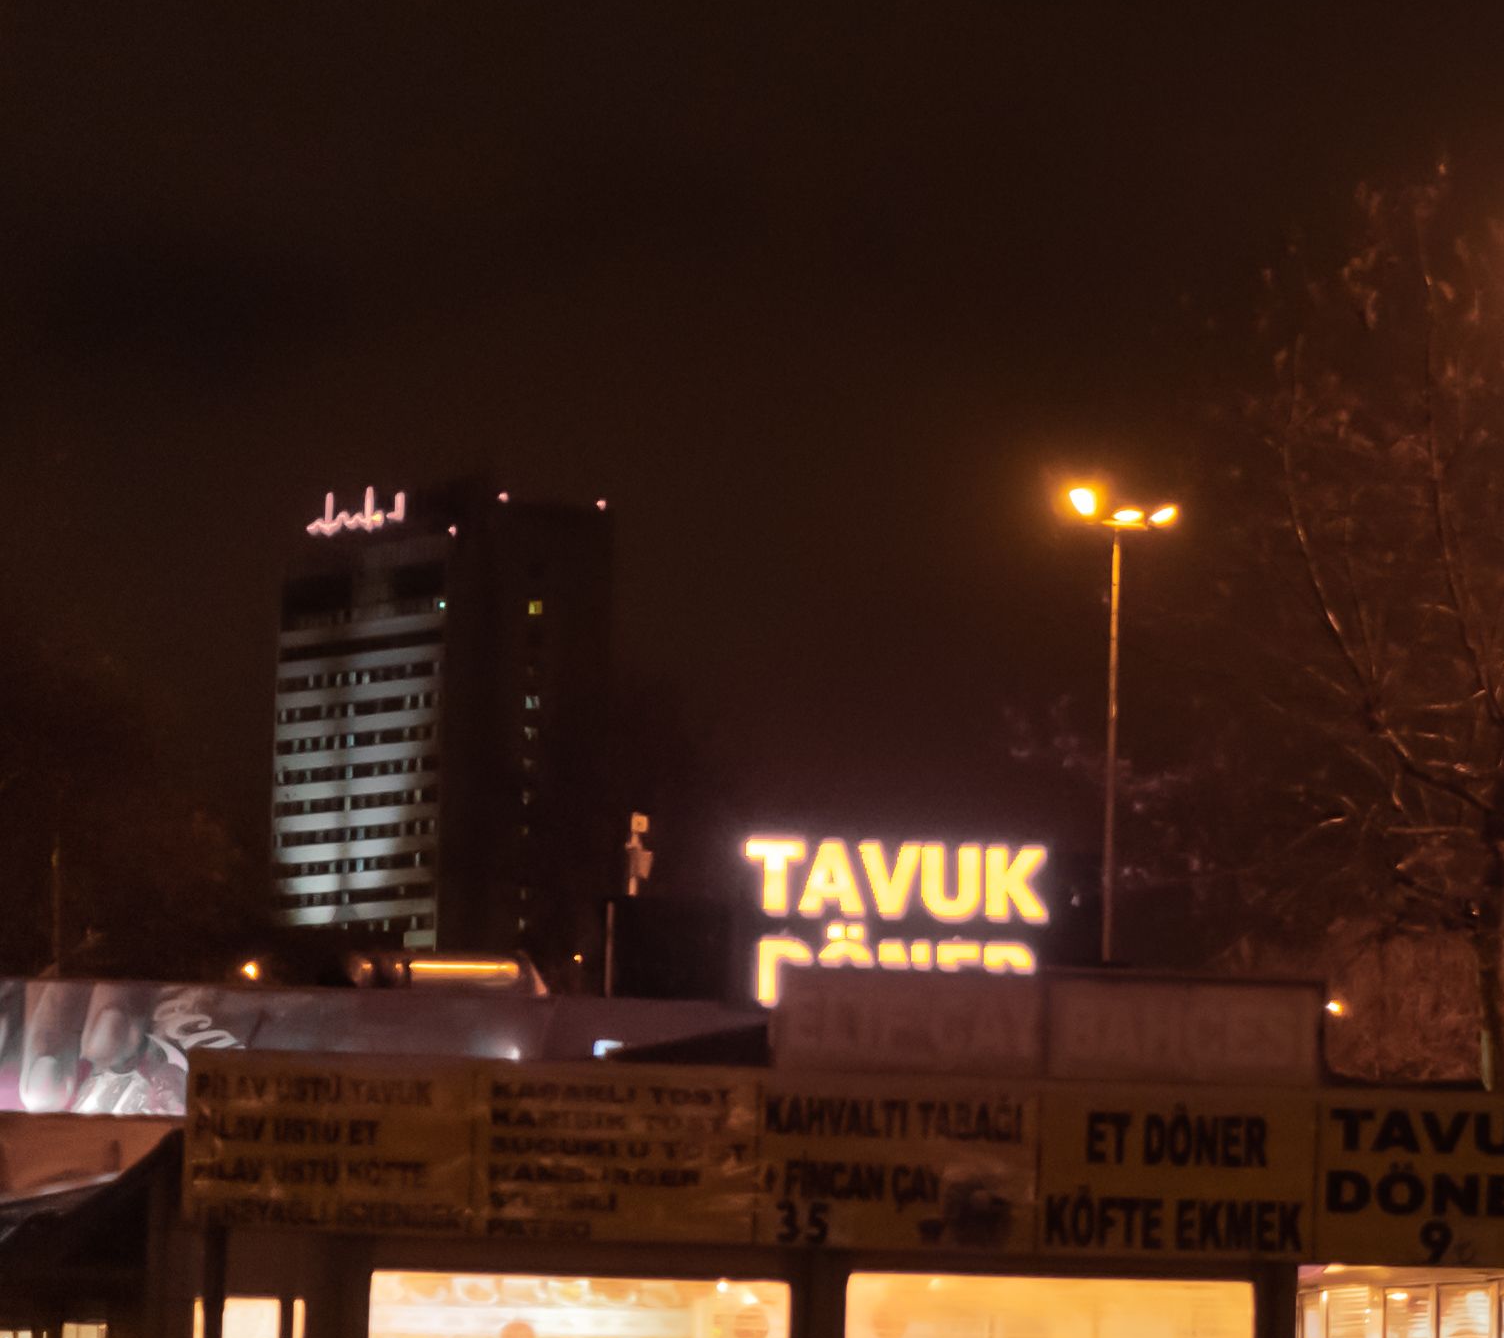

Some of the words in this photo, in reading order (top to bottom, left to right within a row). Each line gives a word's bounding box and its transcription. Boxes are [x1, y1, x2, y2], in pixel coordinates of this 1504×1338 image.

[744, 837, 1049, 923] TAVUK
[649, 1086, 733, 1106] TOST
[348, 1119, 380, 1146] ET
[645, 1113, 726, 1135] TOST
[765, 1095, 908, 1138] KAHVALTI
[917, 1096, 1024, 1144] TABAĞI
[1086, 1112, 1132, 1163] ET
[1143, 1103, 1268, 1168] DÖNER
[662, 1142, 749, 1163] TOST
[783, 1152, 885, 1200] FİNCAN
[892, 1166, 942, 1213] ÇAY
[776, 1200, 830, 1245] 35
[1045, 1183, 1165, 1251] KÖFTE
[1175, 1198, 1302, 1253] EKMEK
[1420, 1221, 1452, 1262] 9
